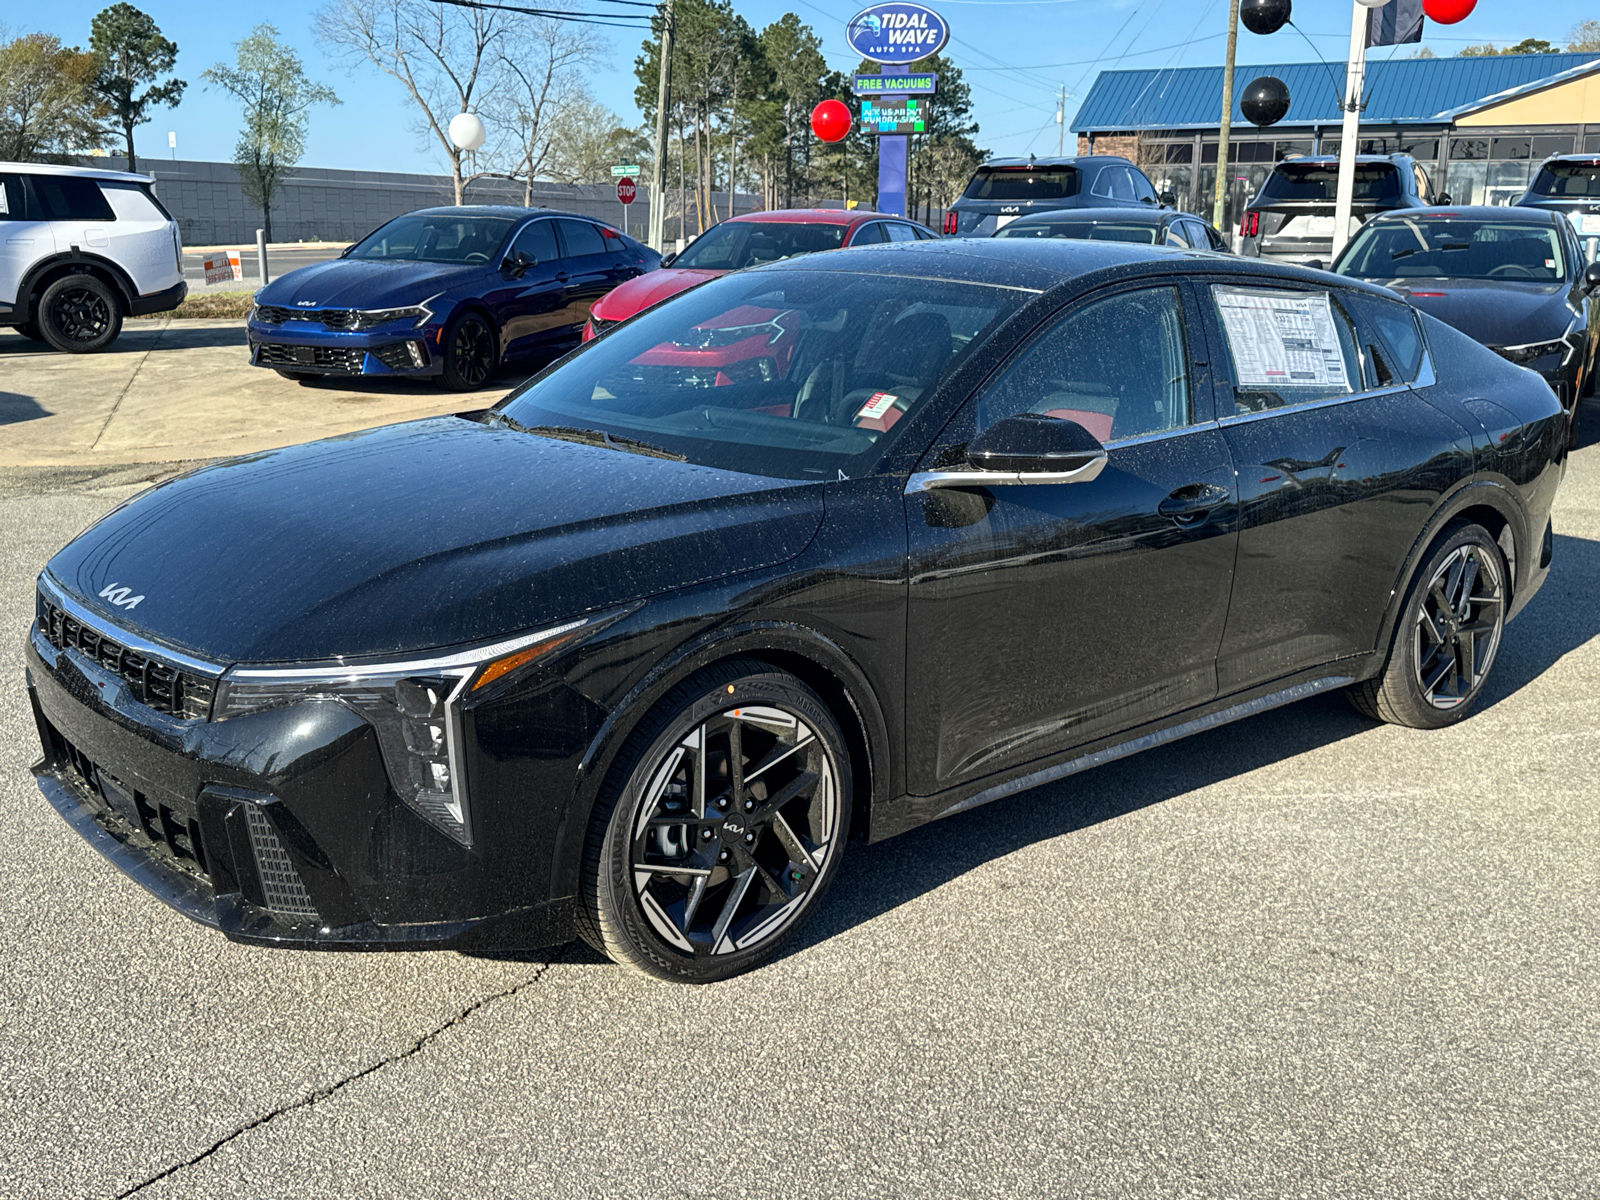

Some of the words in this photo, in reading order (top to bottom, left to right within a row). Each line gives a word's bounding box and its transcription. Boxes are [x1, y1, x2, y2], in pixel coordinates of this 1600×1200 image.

[881, 13, 928, 28] TIDAL
[888, 29, 937, 44] WAVE
[857, 79, 882, 89] FREE
[885, 78, 932, 89] VACUUMS
[618, 185, 636, 197] STOP
[99, 582, 145, 611] KIA
[723, 821, 745, 835] KIA
